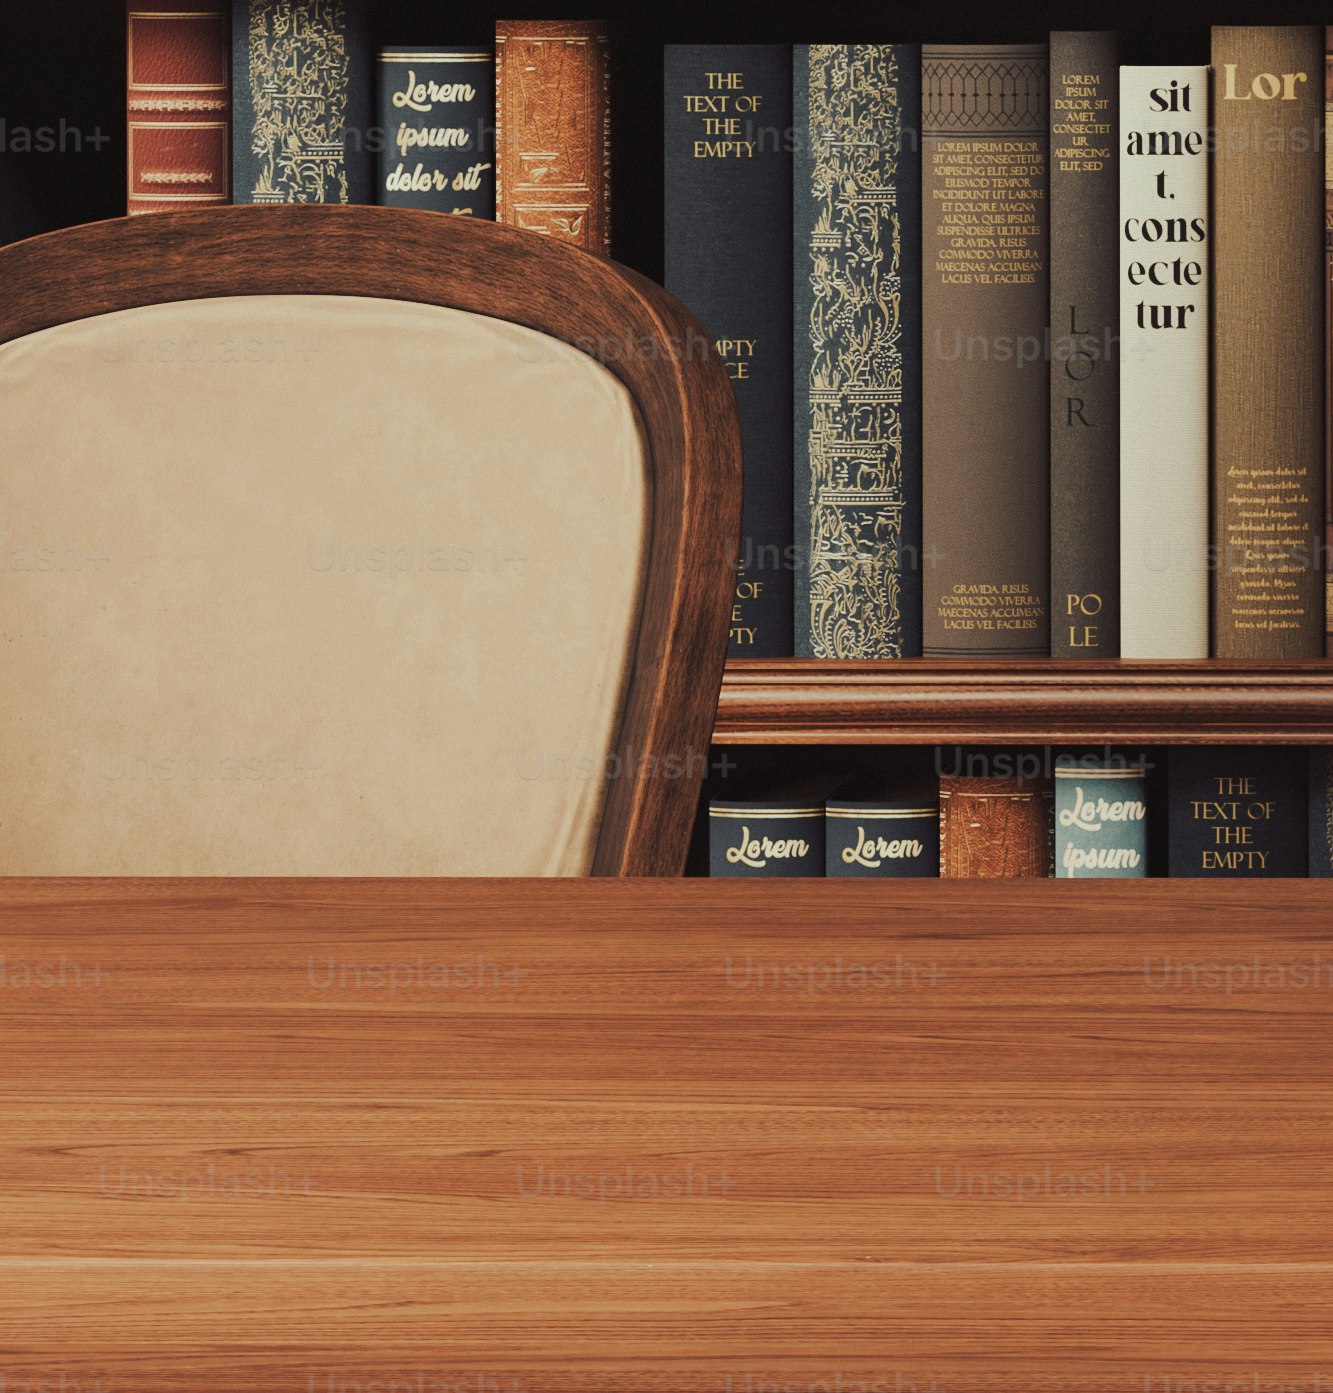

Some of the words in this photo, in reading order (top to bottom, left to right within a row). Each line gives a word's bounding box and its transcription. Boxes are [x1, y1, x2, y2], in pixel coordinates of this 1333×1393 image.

[705, 73, 743, 89] THE
[1220, 63, 1306, 105] Lor
[683, 95, 729, 112] TEXT
[735, 96, 762, 112] OF
[1150, 80, 1190, 112] sit
[702, 118, 741, 135] THE
[694, 141, 755, 158] EMPTY
[1127, 131, 1203, 155] ame
[1157, 171, 1174, 199] t.
[1125, 213, 1209, 247] cons
[1128, 258, 1202, 285] ecte
[1137, 302, 1195, 329] tur
[1217, 778, 1255, 795] THE
[1056, 787, 1144, 835] Lorem
[1191, 802, 1241, 820] TEXT
[1247, 802, 1274, 820] OF
[726, 826, 809, 868] Lorem
[842, 826, 923, 868] Lorem
[1212, 826, 1253, 844] THE
[1202, 851, 1267, 869] EMPTY
